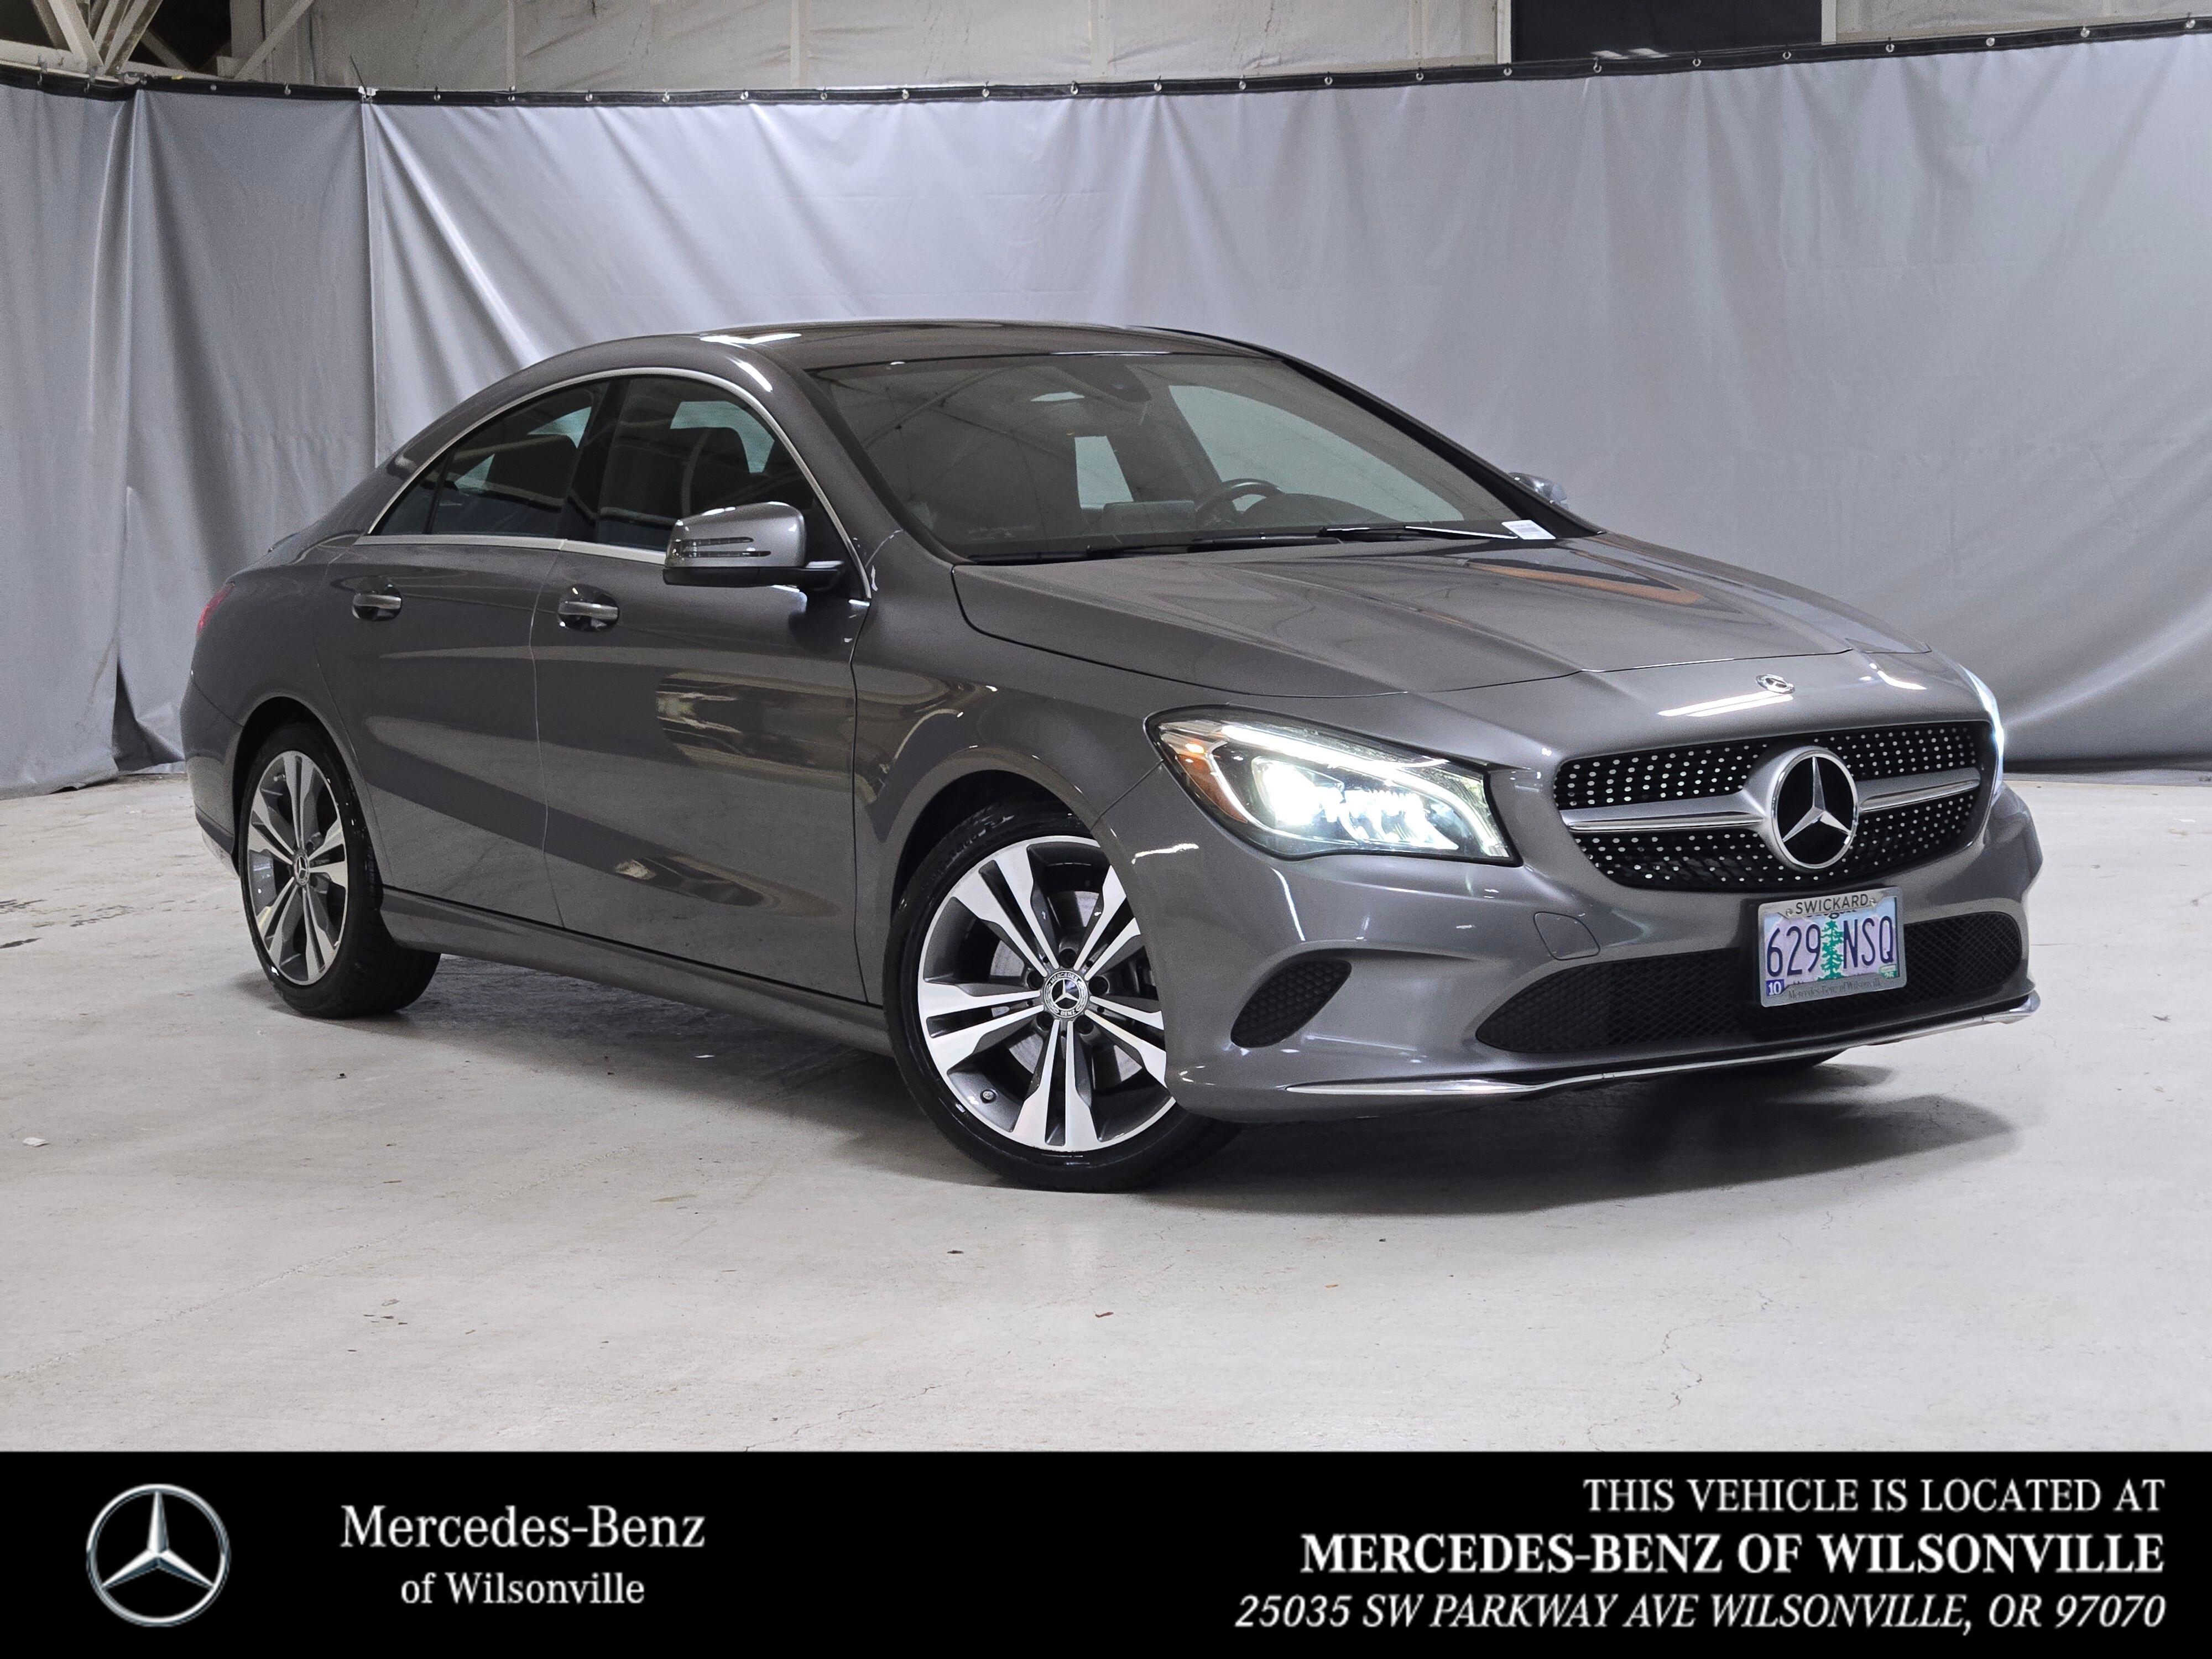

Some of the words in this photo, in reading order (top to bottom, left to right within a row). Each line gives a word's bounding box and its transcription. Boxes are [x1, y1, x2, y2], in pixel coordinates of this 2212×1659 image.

[1796, 894, 1869, 914] SWICKARD
[1767, 924, 1821, 977] 629
[1844, 915, 1894, 969] NSQ
[1050, 972, 1078, 984] MERCEDES
[1768, 981, 1782, 995] 10
